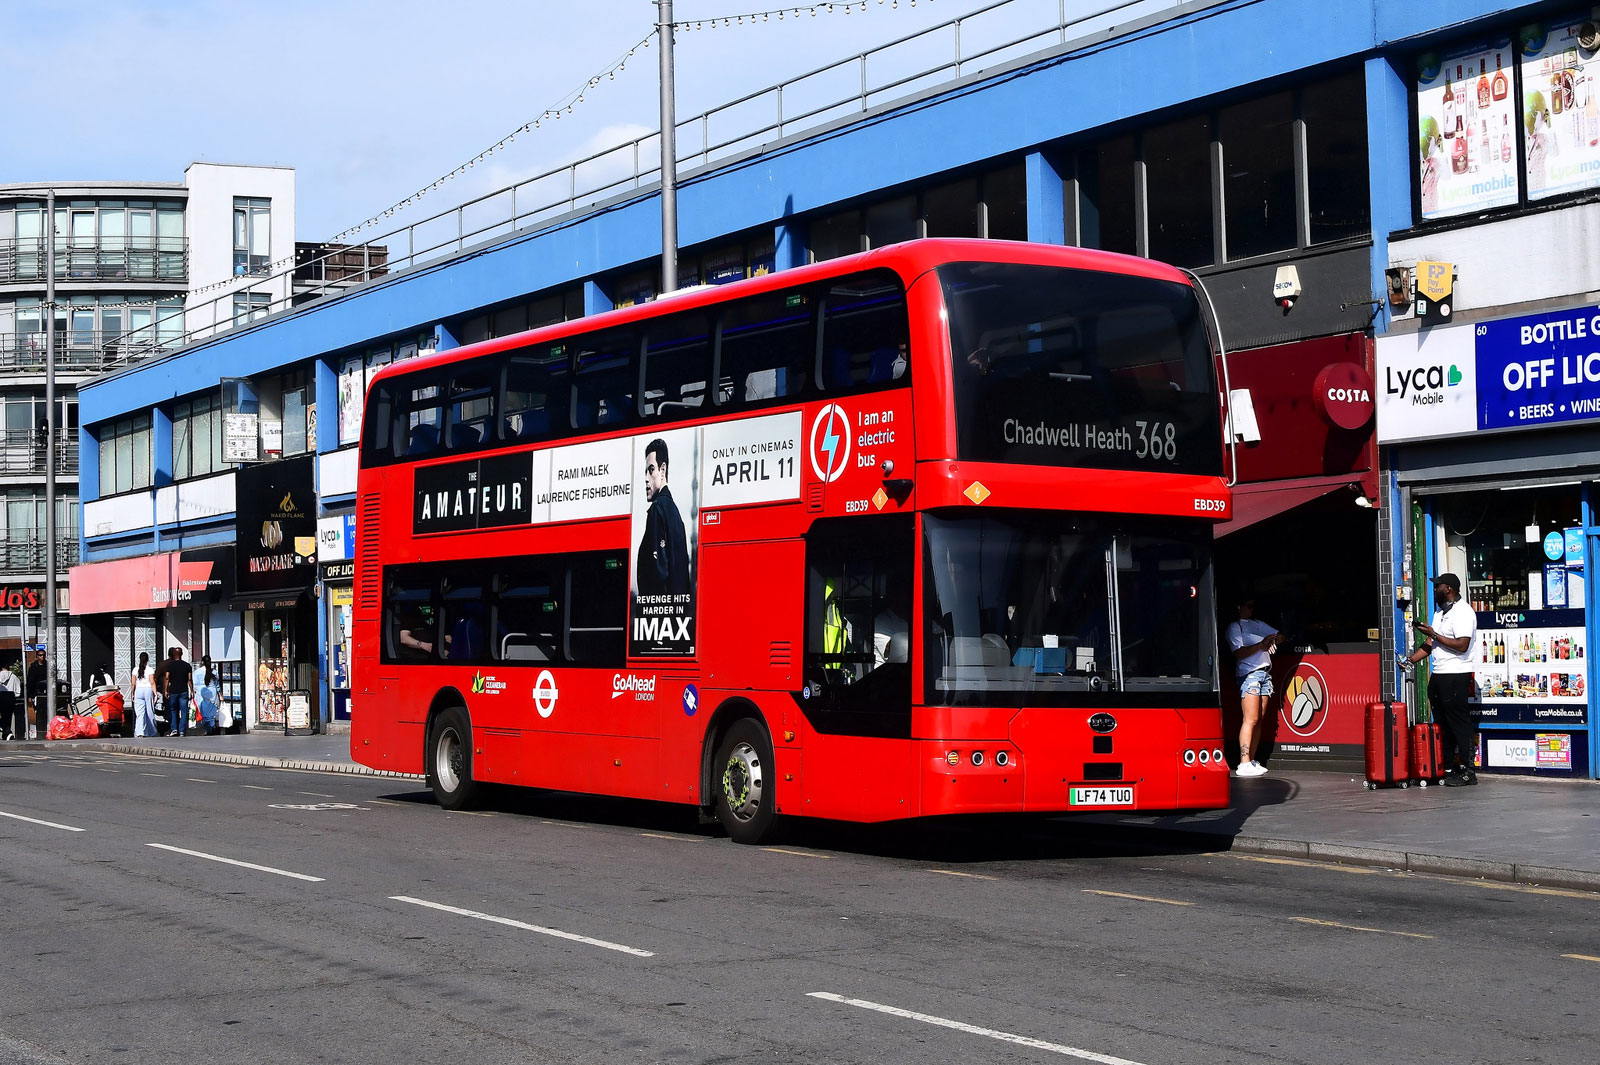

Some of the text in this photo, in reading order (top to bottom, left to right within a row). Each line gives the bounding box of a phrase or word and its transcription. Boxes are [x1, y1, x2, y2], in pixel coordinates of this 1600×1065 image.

[1428, 285, 1444, 294] Point
[1476, 325, 1487, 336] 60
[1520, 318, 1586, 345] BOTTLE
[1386, 365, 1443, 399] Lyca
[1502, 358, 1554, 391] OFF
[1328, 388, 1370, 403] COSTA
[1412, 392, 1443, 406] Mobile
[858, 410, 894, 427] I am an
[1519, 403, 1554, 420] BEERS
[858, 428, 895, 447] electric
[1003, 418, 1177, 461] Chadwell Heath 368
[712, 439, 794, 459] ONLY IN CINEMAS
[857, 452, 876, 468] bus
[468, 472, 477, 481] THE
[558, 464, 609, 481] RAMI MALEK
[711, 456, 794, 486] APRIL 11
[422, 482, 522, 520] AMATEUR
[537, 484, 631, 505] LAURENCE FISHBURNE
[845, 500, 869, 512] EBD39
[1194, 498, 1226, 512] EBD39
[320, 529, 336, 545] Lyca
[1546, 543, 1562, 552] ZYN
[327, 565, 341, 577] OFF
[152, 587, 192, 603] Bairstow eves
[636, 594, 691, 604] REVENGE HITS
[643, 606, 684, 615] HARDER IN
[1495, 612, 1518, 625] Lyca
[633, 617, 691, 641] IMAX
[612, 673, 656, 692] GoAhead
[635, 692, 655, 701] LONDON
[1481, 708, 1498, 716] world
[1535, 708, 1583, 717] LycaMobile.co.uk
[1505, 744, 1528, 757] Lyca
[1077, 789, 1131, 803] LF74 TUO
